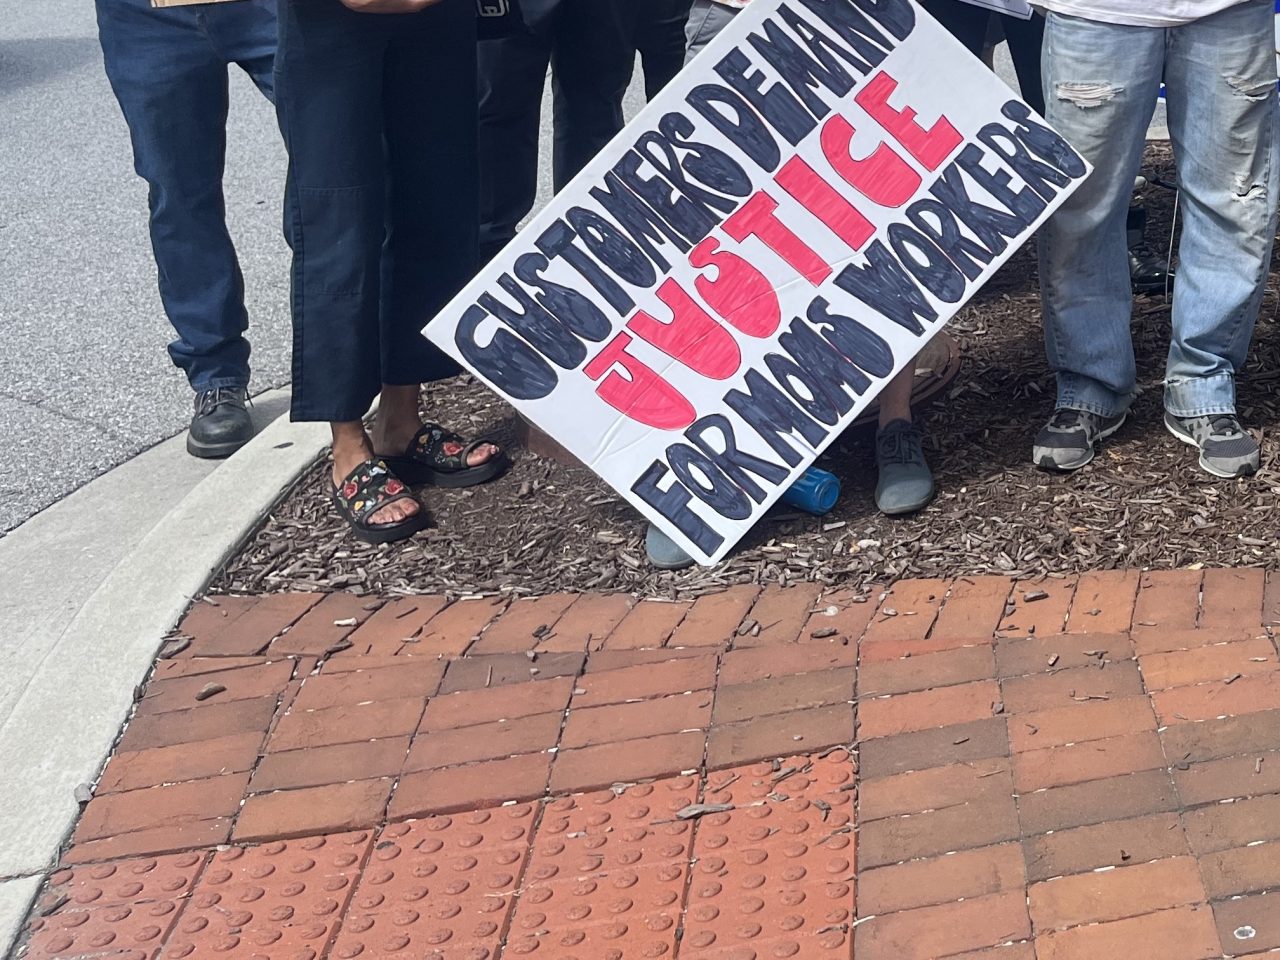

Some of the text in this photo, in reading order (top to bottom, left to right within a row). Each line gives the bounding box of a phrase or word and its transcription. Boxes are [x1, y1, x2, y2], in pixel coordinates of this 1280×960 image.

[454, 112, 753, 401] CUSTOMERS
[582, 70, 965, 431] JUSTICE
[631, 414, 791, 558] FOR
[722, 295, 894, 450] MOMS
[834, 100, 1086, 337] WORKERS
